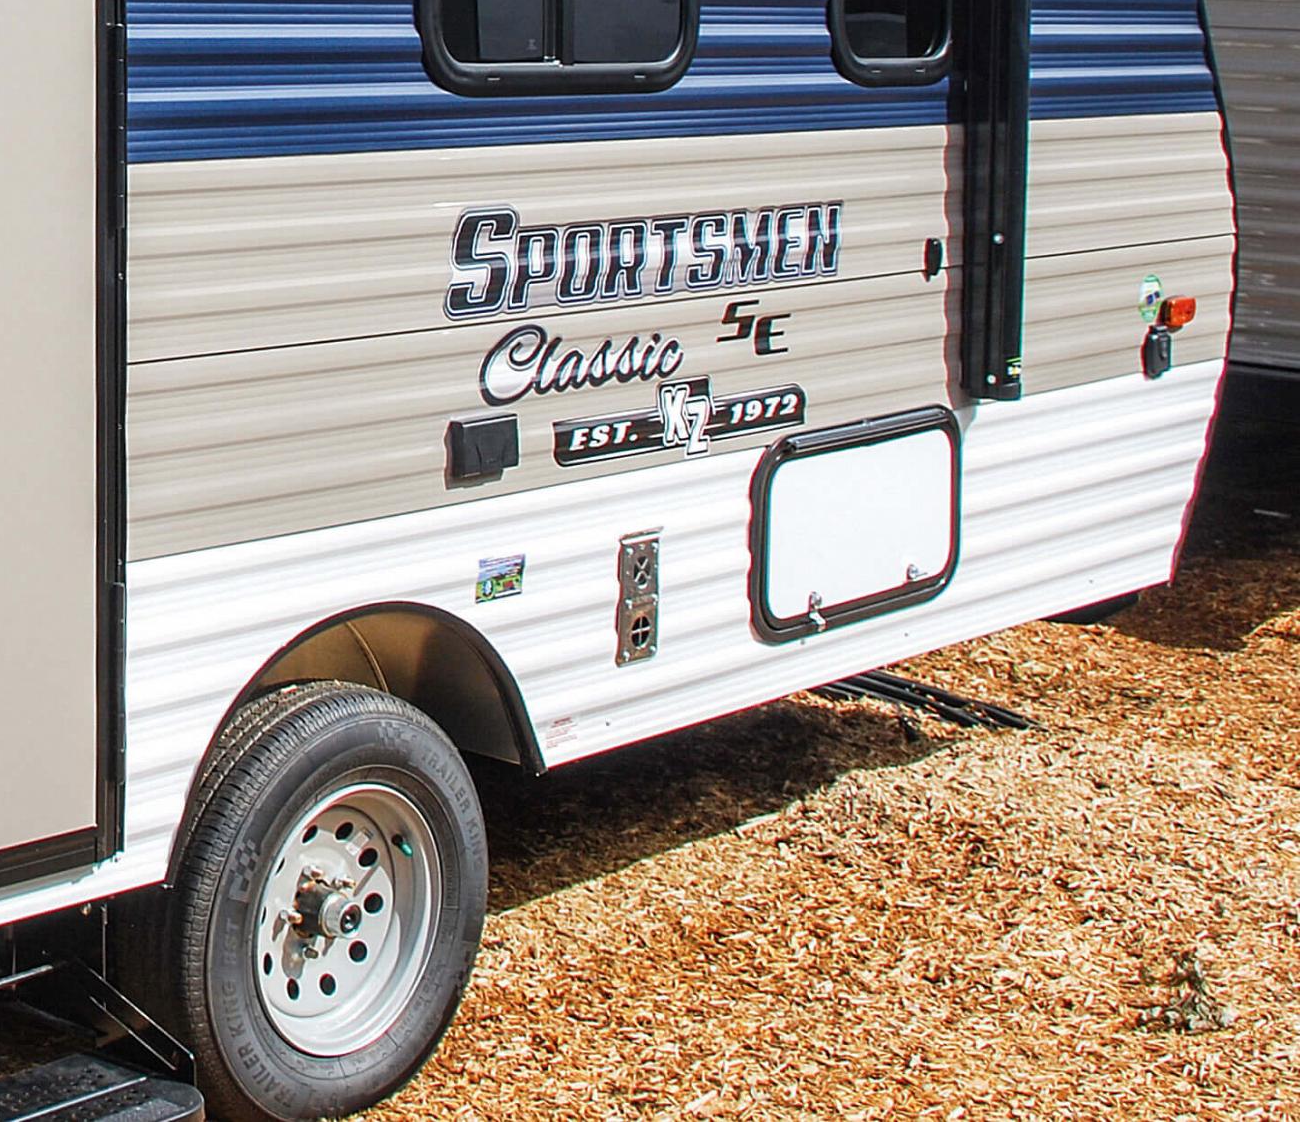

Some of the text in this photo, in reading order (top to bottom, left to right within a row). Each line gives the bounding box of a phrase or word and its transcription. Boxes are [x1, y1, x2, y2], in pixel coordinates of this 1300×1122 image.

[443, 201, 844, 320] SPORTSMEN
[716, 298, 792, 356] SE
[478, 323, 684, 408] Classic
[568, 383, 799, 458] EST. KZ 1972
[222, 981, 245, 1039] KING
[238, 1043, 297, 1108] TRAILER
